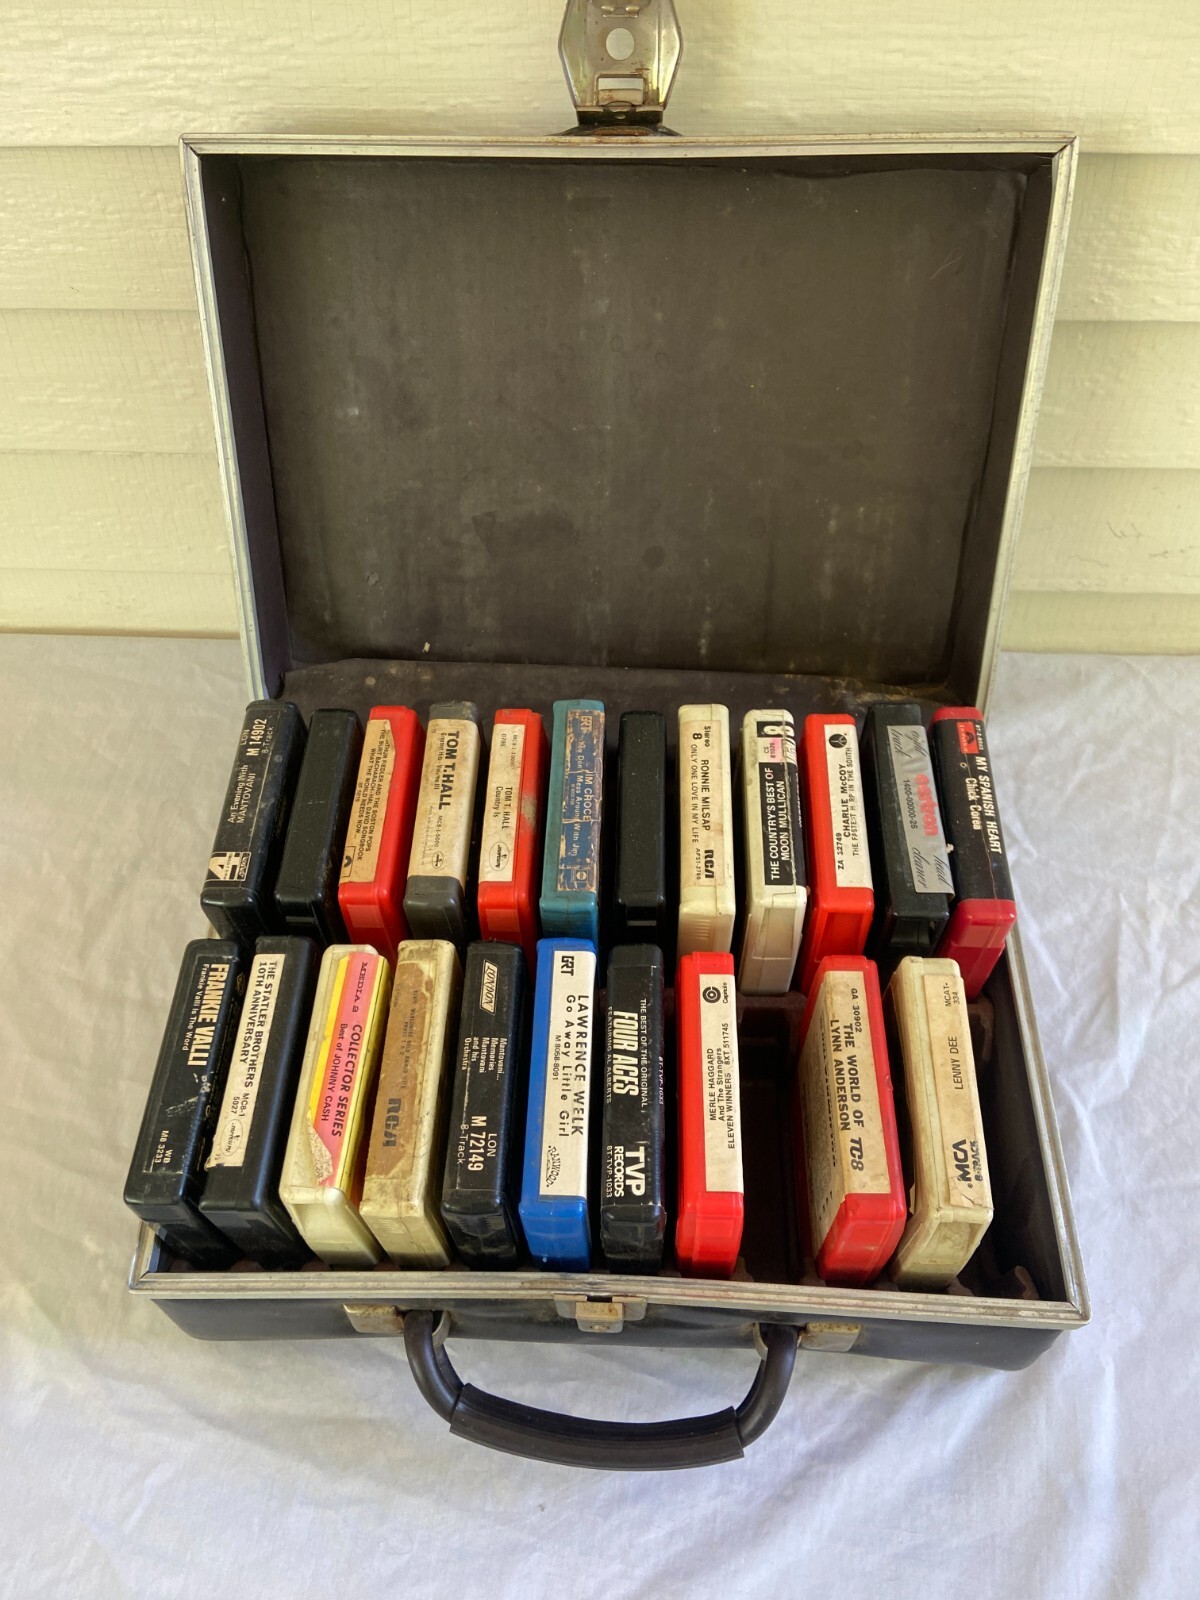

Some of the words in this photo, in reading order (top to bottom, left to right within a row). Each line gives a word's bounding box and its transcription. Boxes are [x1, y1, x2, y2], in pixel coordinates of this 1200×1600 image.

[240, 729, 249, 745] LON
[249, 719, 267, 745] 14902
[262, 727, 273, 754] 8-Track
[445, 731, 459, 759] TOM
[891, 729, 911, 756] track
[368, 748, 376, 764] WHAT
[376, 741, 384, 755] BURT
[690, 744, 698, 763] ONLY
[237, 765, 248, 780] With
[379, 760, 388, 782] FIEDLER
[701, 760, 710, 793] RONNIE
[765, 767, 774, 779] OF
[975, 756, 988, 772] MY
[362, 778, 371, 798] WORLD
[575, 775, 583, 795] Mess
[839, 764, 847, 794] McCOY
[848, 784, 855, 792] IN
[965, 777, 979, 801] Chick
[231, 782, 245, 809] Evening
[237, 773, 256, 823] MANTOVANI
[373, 797, 381, 808] THE
[493, 786, 503, 810] Country
[504, 787, 513, 801] TOM
[583, 788, 593, 821] CROCE
[765, 782, 775, 804] BEST
[776, 780, 787, 828] MULLICAN
[978, 775, 995, 817] SPANISH
[228, 812, 236, 823] An
[359, 799, 367, 818] NEEDS
[363, 807, 372, 824] DAVID
[368, 810, 378, 834] BOSTON
[501, 811, 510, 830] HALL
[692, 813, 698, 824] MY
[702, 796, 710, 831] MILSAP
[841, 798, 850, 838] CHARLIE
[969, 805, 981, 830] Corea
[357, 826, 369, 861] SONGBOOK
[767, 805, 779, 859] COUNTRY'S
[986, 821, 1002, 854] HEART
[571, 843, 580, 856] Jim
[779, 832, 790, 860] MOON
[704, 850, 714, 878] RCA
[771, 861, 780, 880] THE
[838, 860, 844, 870] ZA
[912, 847, 930, 889] cleaner
[933, 855, 954, 890] head
[197, 964, 209, 990] Frankie
[254, 962, 267, 987] 10TH
[267, 961, 277, 980] THE
[354, 962, 368, 1003] MEDIA
[192, 991, 204, 1007] Valli
[198, 963, 229, 1023] FRANKIE
[256, 983, 273, 1028] STATLER
[565, 995, 575, 1013] Go
[943, 983, 951, 1007] MCAT-
[187, 1017, 197, 1029] The
[239, 990, 260, 1064] ANNIVERSARY
[337, 1023, 348, 1040] Best
[613, 1011, 638, 1051] FOUR
[852, 1005, 862, 1032] 30902
[182, 1032, 194, 1051] Word
[188, 1026, 215, 1066] VALLI
[336, 1043, 342, 1051] of
[561, 1021, 574, 1057] Away
[575, 994, 589, 1082] LAWRENCE
[640, 1036, 647, 1046] OF
[830, 1019, 842, 1052] LYNN
[843, 1023, 854, 1048] THE
[948, 1036, 959, 1054] DEE
[244, 1031, 263, 1087] BROTHERS
[340, 1024, 362, 1092] COLLECTOR
[462, 1037, 471, 1070] Orchestra
[471, 1051, 479, 1062] his
[479, 1037, 489, 1073] Mantovani
[488, 1038, 498, 1071] Memories
[607, 1054, 612, 1065] AL
[715, 1048, 724, 1085] Strangers
[722, 1051, 730, 1065] 8XT
[327, 1053, 341, 1093] JOHNNY
[612, 1054, 638, 1096] ACES
[707, 1048, 715, 1088] HAGGARD
[847, 1055, 861, 1103] WORLD
[951, 1058, 963, 1090] LENNY
[560, 1066, 572, 1101] Little
[834, 1059, 850, 1131] ANDERSON
[230, 1096, 240, 1114] 5027
[239, 1093, 249, 1117] MC8-1
[321, 1096, 334, 1122] CASH
[331, 1096, 349, 1137] SERIES
[572, 1091, 585, 1136] WELK
[383, 1098, 402, 1147] RCA
[471, 1116, 487, 1126] M
[558, 1110, 569, 1137] Girl
[727, 1115, 735, 1148] ELEVEN
[853, 1110, 864, 1128] OF
[154, 1144, 166, 1163] 3233
[163, 1149, 174, 1164] WB
[457, 1124, 469, 1164] 8-Track
[468, 1132, 486, 1171] 72149
[487, 1133, 497, 1157] LON
[849, 1137, 864, 1171] TC8
[614, 1146, 624, 1197] RECORDS
[625, 1146, 645, 1196] TVP
[952, 1139, 971, 1182] MCA
